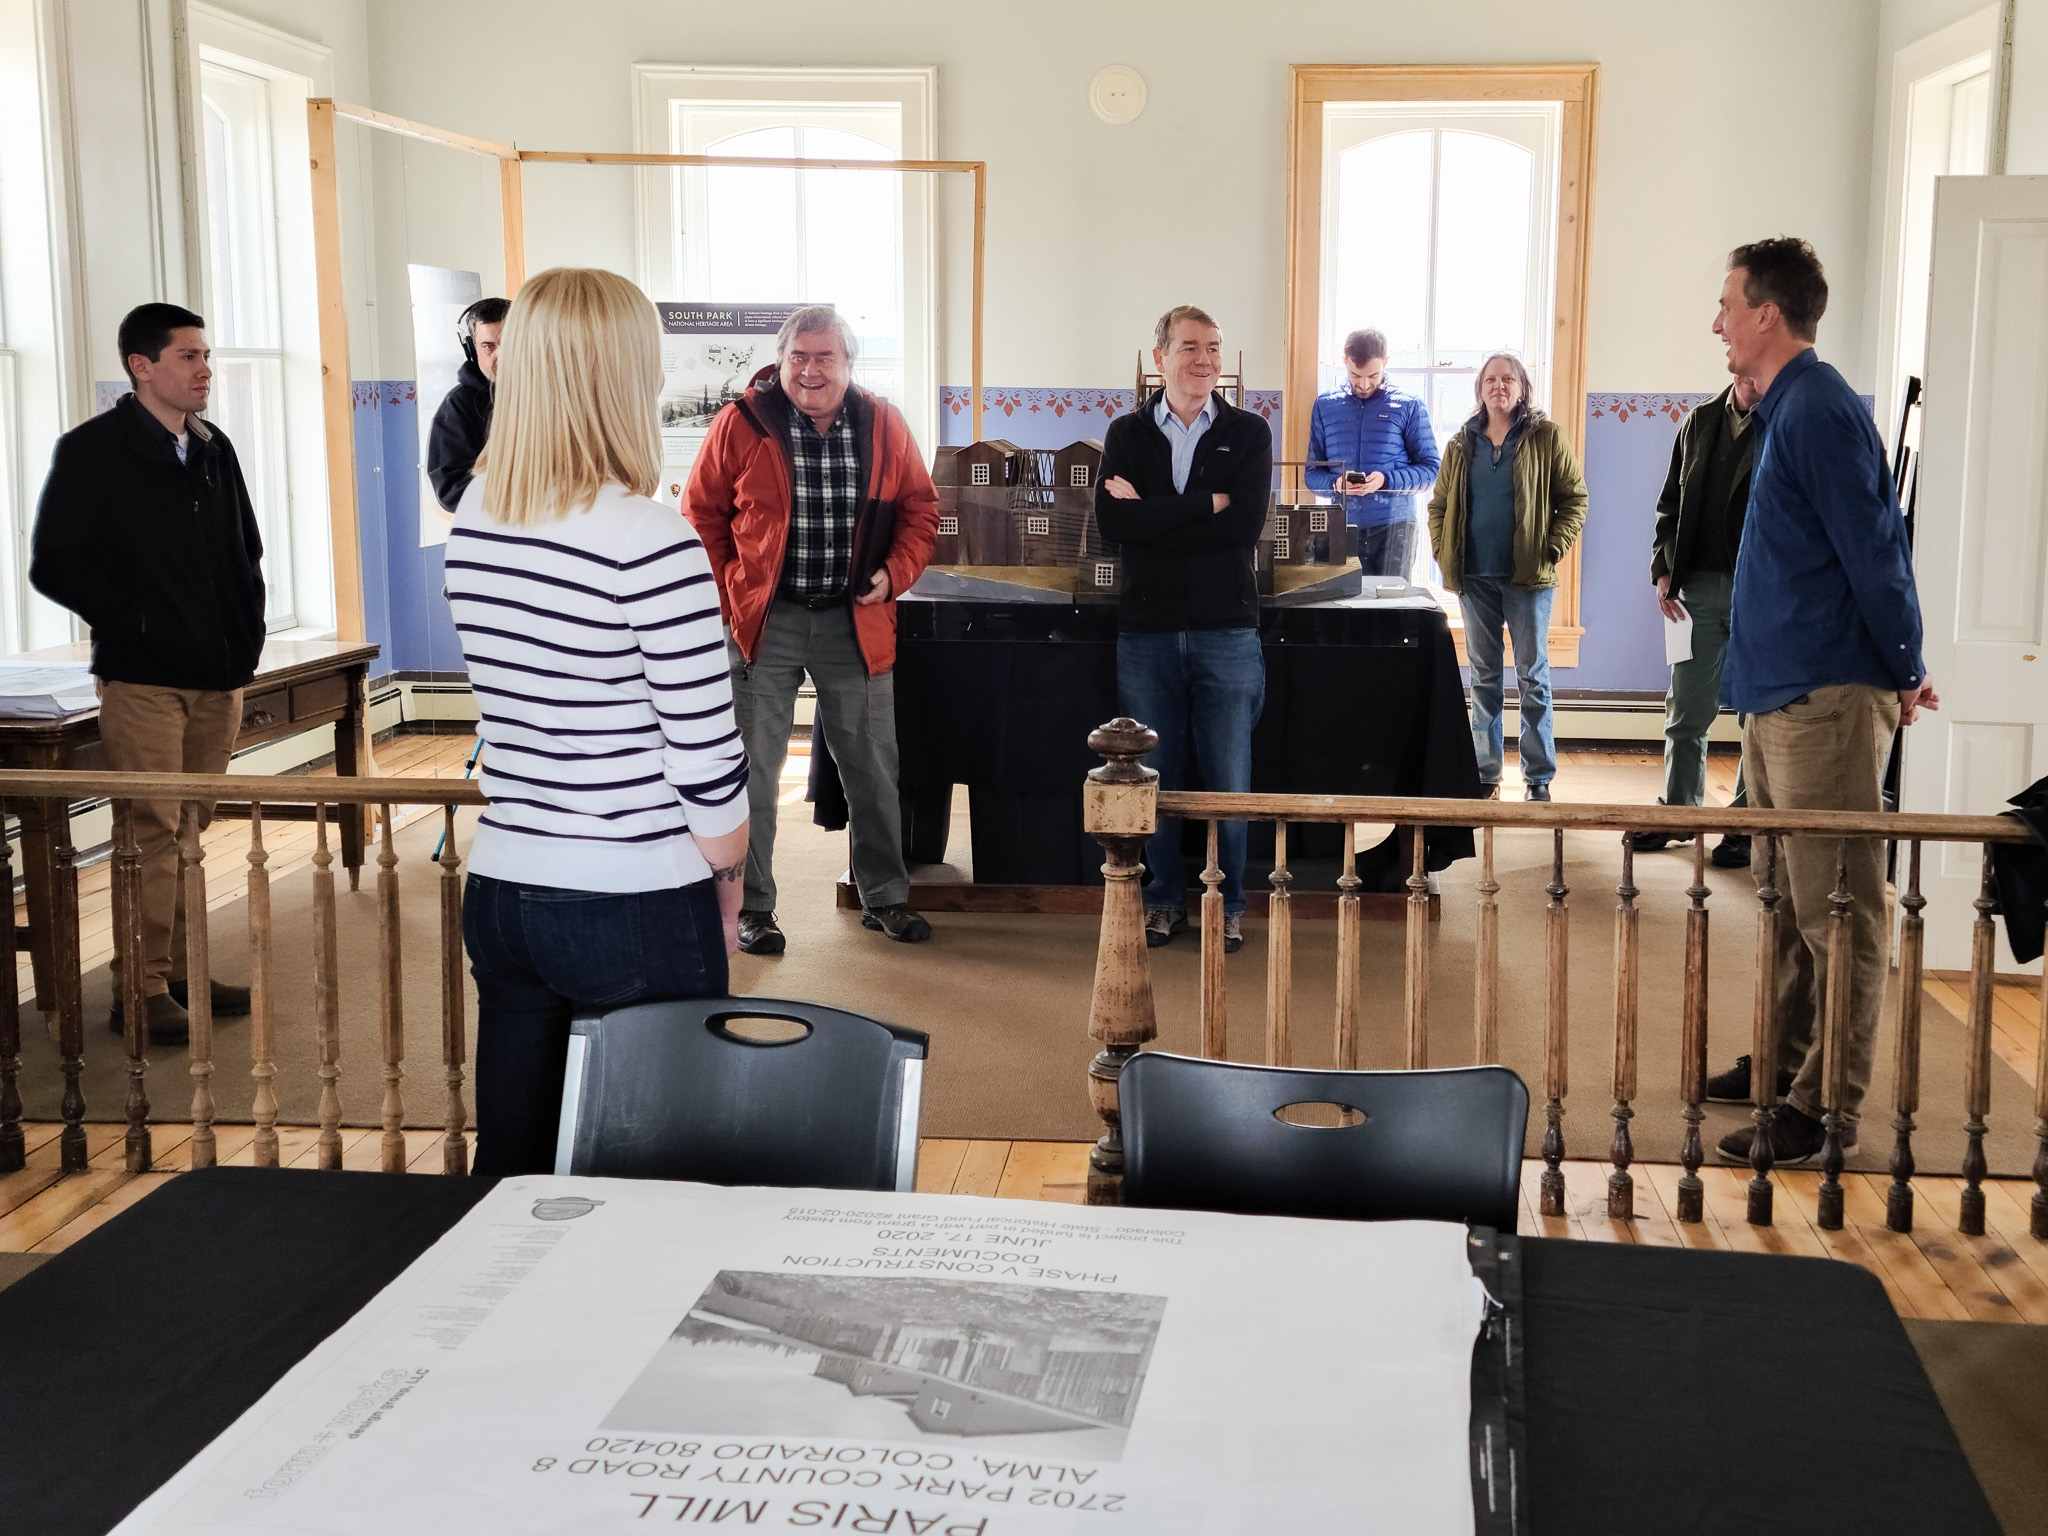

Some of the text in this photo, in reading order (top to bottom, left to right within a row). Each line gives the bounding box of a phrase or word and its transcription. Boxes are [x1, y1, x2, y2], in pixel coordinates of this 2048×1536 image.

[668, 311, 733, 320] SOUTH PARK
[789, 1207, 893, 1220] #2020-02-015
[896, 1213, 939, 1222] Grant
[782, 1214, 834, 1224] History
[876, 1219, 916, 1227] grant
[943, 1215, 982, 1223] Fund
[986, 1217, 1056, 1228] Historical
[935, 1222, 964, 1230] with
[969, 1223, 999, 1231] part
[1004, 1226, 1017, 1234] in
[1060, 1223, 1101, 1233] State
[877, 1230, 936, 1241] 2020
[1022, 1227, 1073, 1239] funded
[1079, 1233, 1091, 1241] is
[1115, 1227, 1185, 1237] Colorado
[985, 1234, 1052, 1248] JUNE
[1096, 1233, 1147, 1243] project
[1152, 1237, 1184, 1245] This
[872, 1247, 1040, 1265] DOCUMENTS
[783, 1256, 1118, 1284] PHASE V CONSTRUCTION
[405, 1369, 430, 1384] LLC
[324, 1368, 408, 1430] works
[584, 1438, 1098, 1485] ALMA, COLORADO 80420
[531, 1457, 1127, 1513] 2702 PARK COUNTY ROAD 8
[630, 1493, 988, 1536] PARIS MILL
